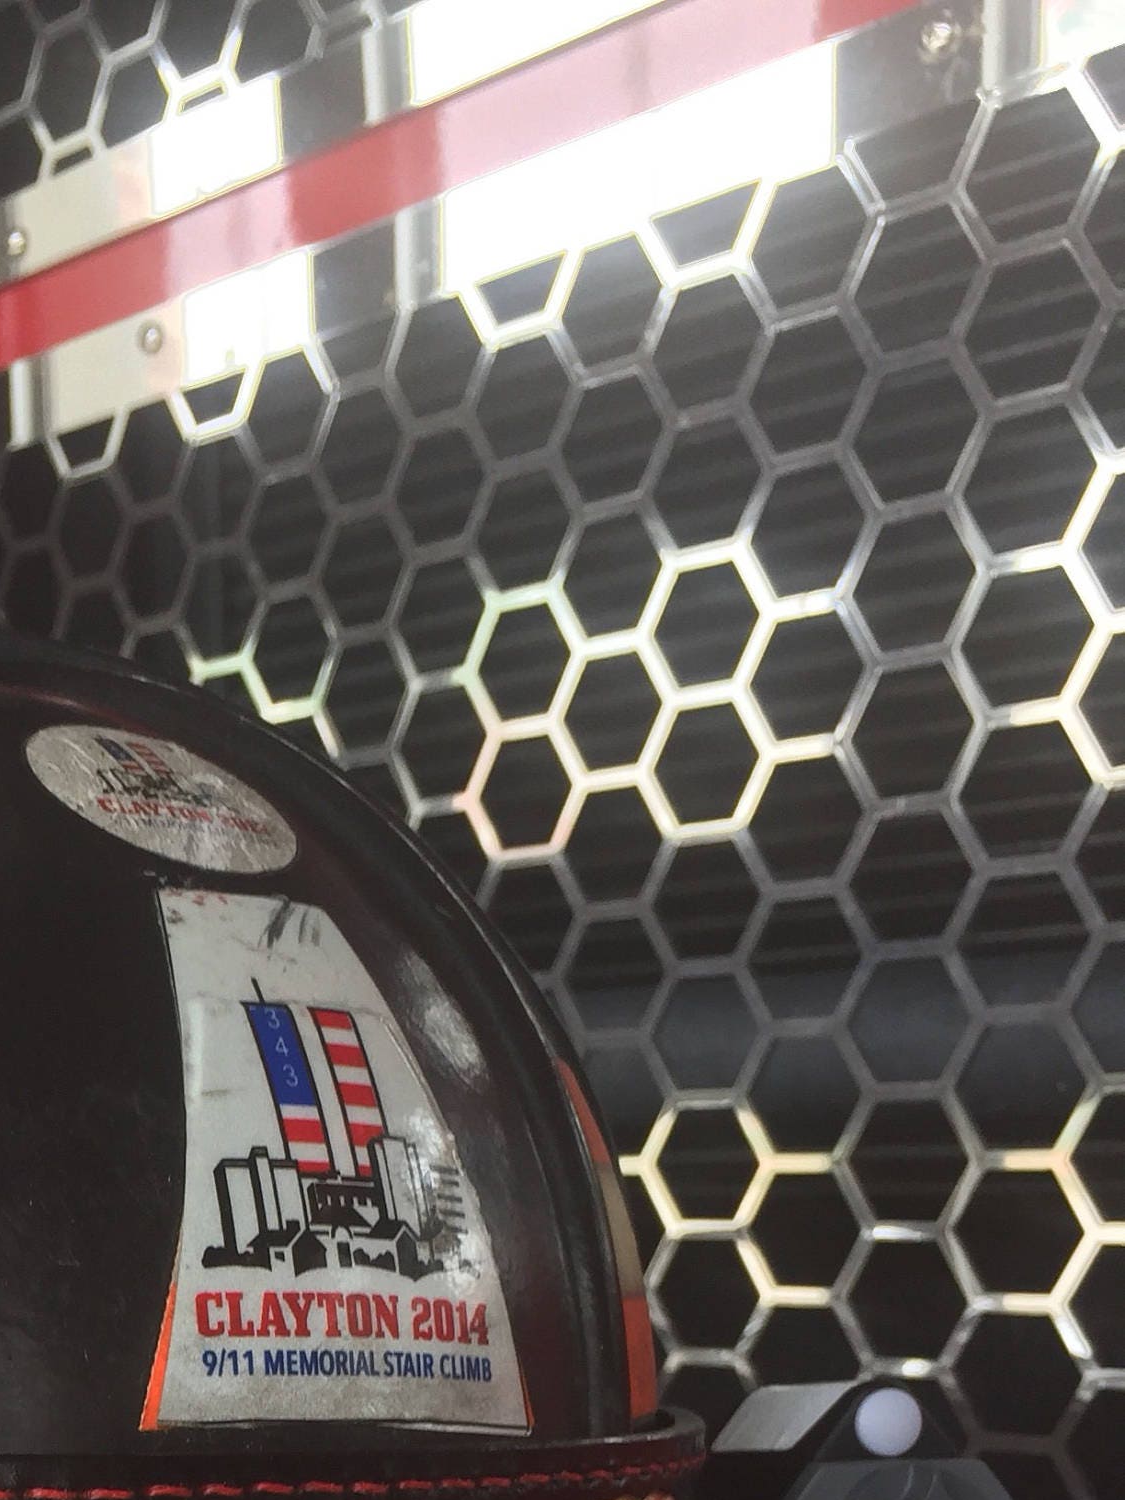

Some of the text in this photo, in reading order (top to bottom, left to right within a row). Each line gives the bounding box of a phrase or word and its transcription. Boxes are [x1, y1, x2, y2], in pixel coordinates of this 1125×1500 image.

[195, 1290, 490, 1345] CLAYTON 2014
[201, 1348, 492, 1382] 9/11 MEMORIAL STAIR CLIMB
